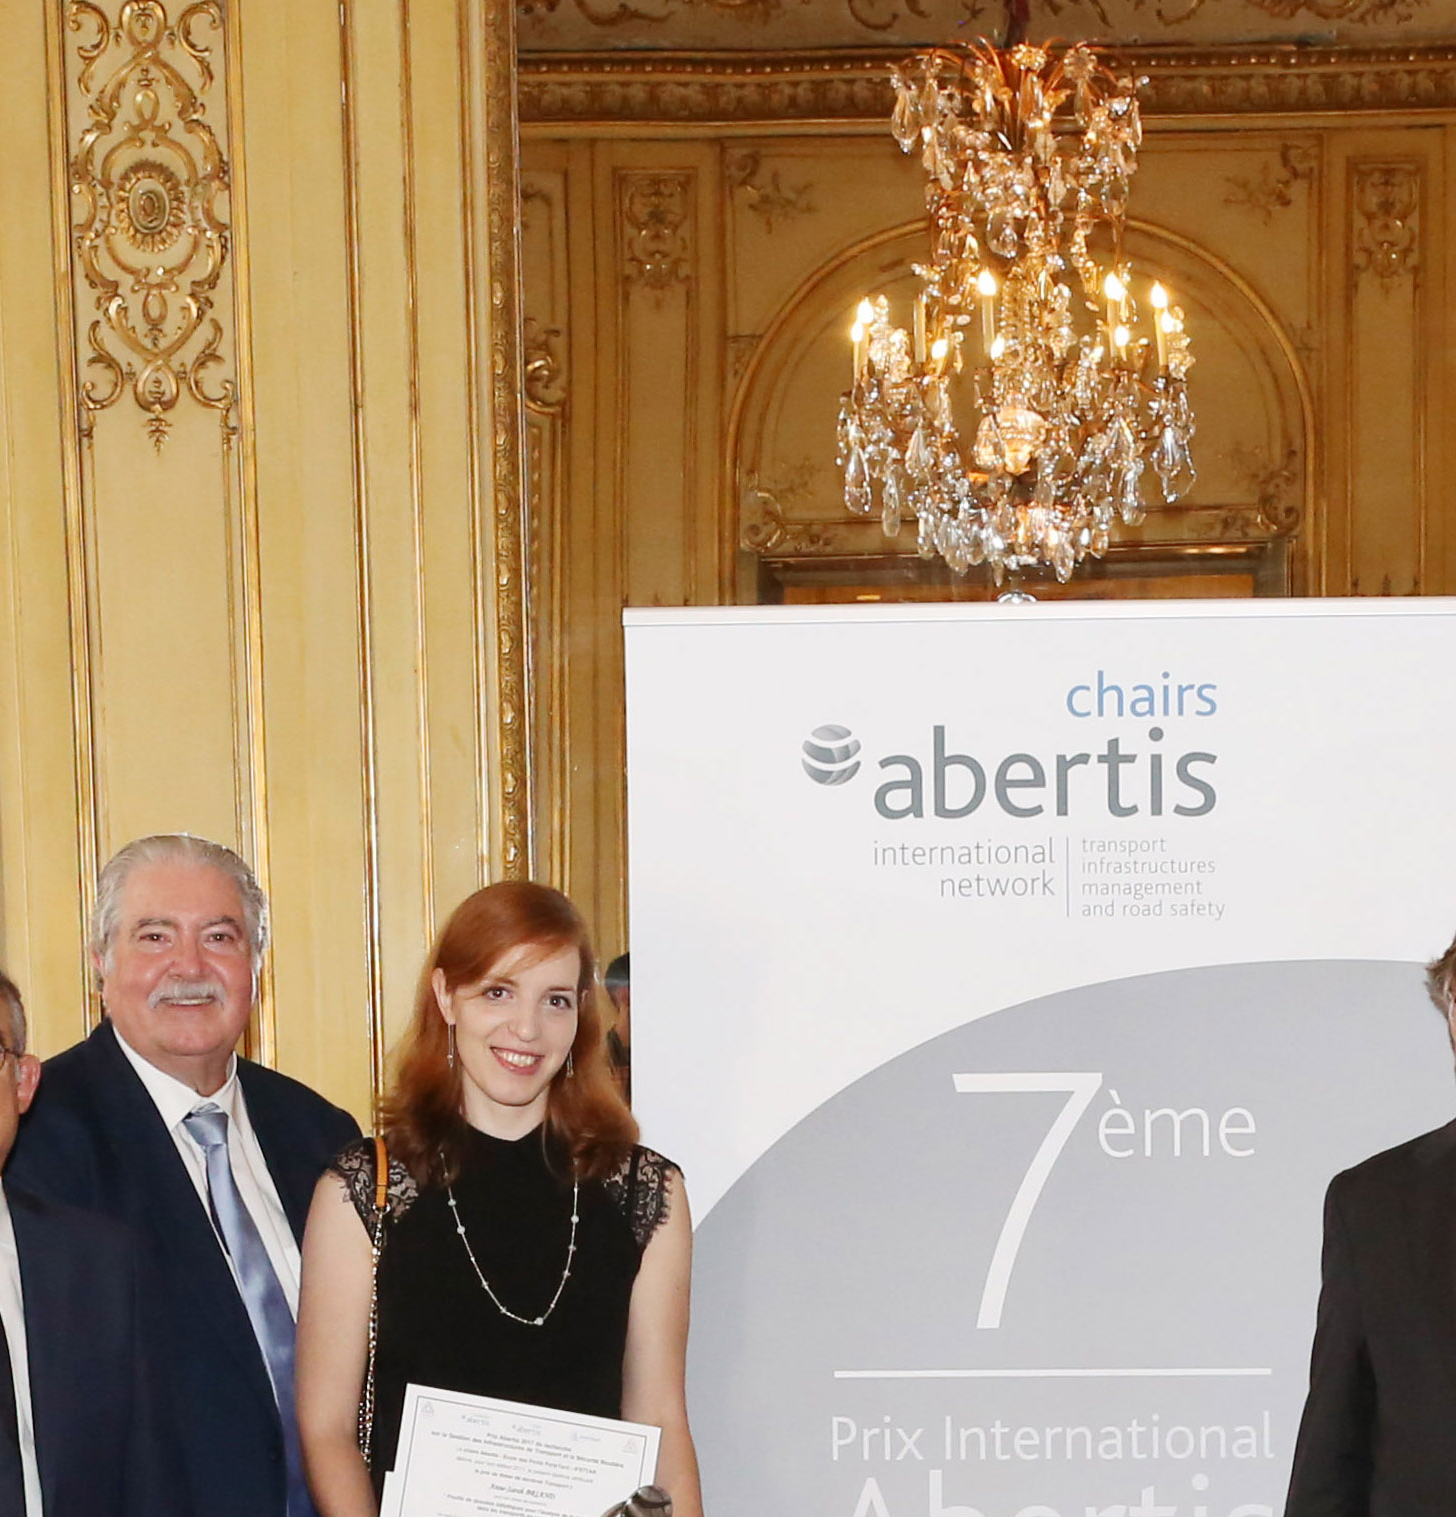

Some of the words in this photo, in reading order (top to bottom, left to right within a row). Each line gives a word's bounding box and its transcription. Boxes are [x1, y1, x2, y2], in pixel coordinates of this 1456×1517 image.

[1067, 670, 1217, 717] chairs
[874, 725, 1217, 820] abertis
[874, 837, 1055, 865] international
[1082, 838, 1166, 859] transport
[1082, 857, 1215, 874] infrastructures
[941, 869, 1055, 897] network
[1082, 880, 1202, 901] management
[1082, 900, 1114, 917] and
[1123, 899, 1162, 916] road
[1170, 899, 1225, 921] safety
[832, 1416, 924, 1460] Prix
[946, 1410, 1275, 1460] International
